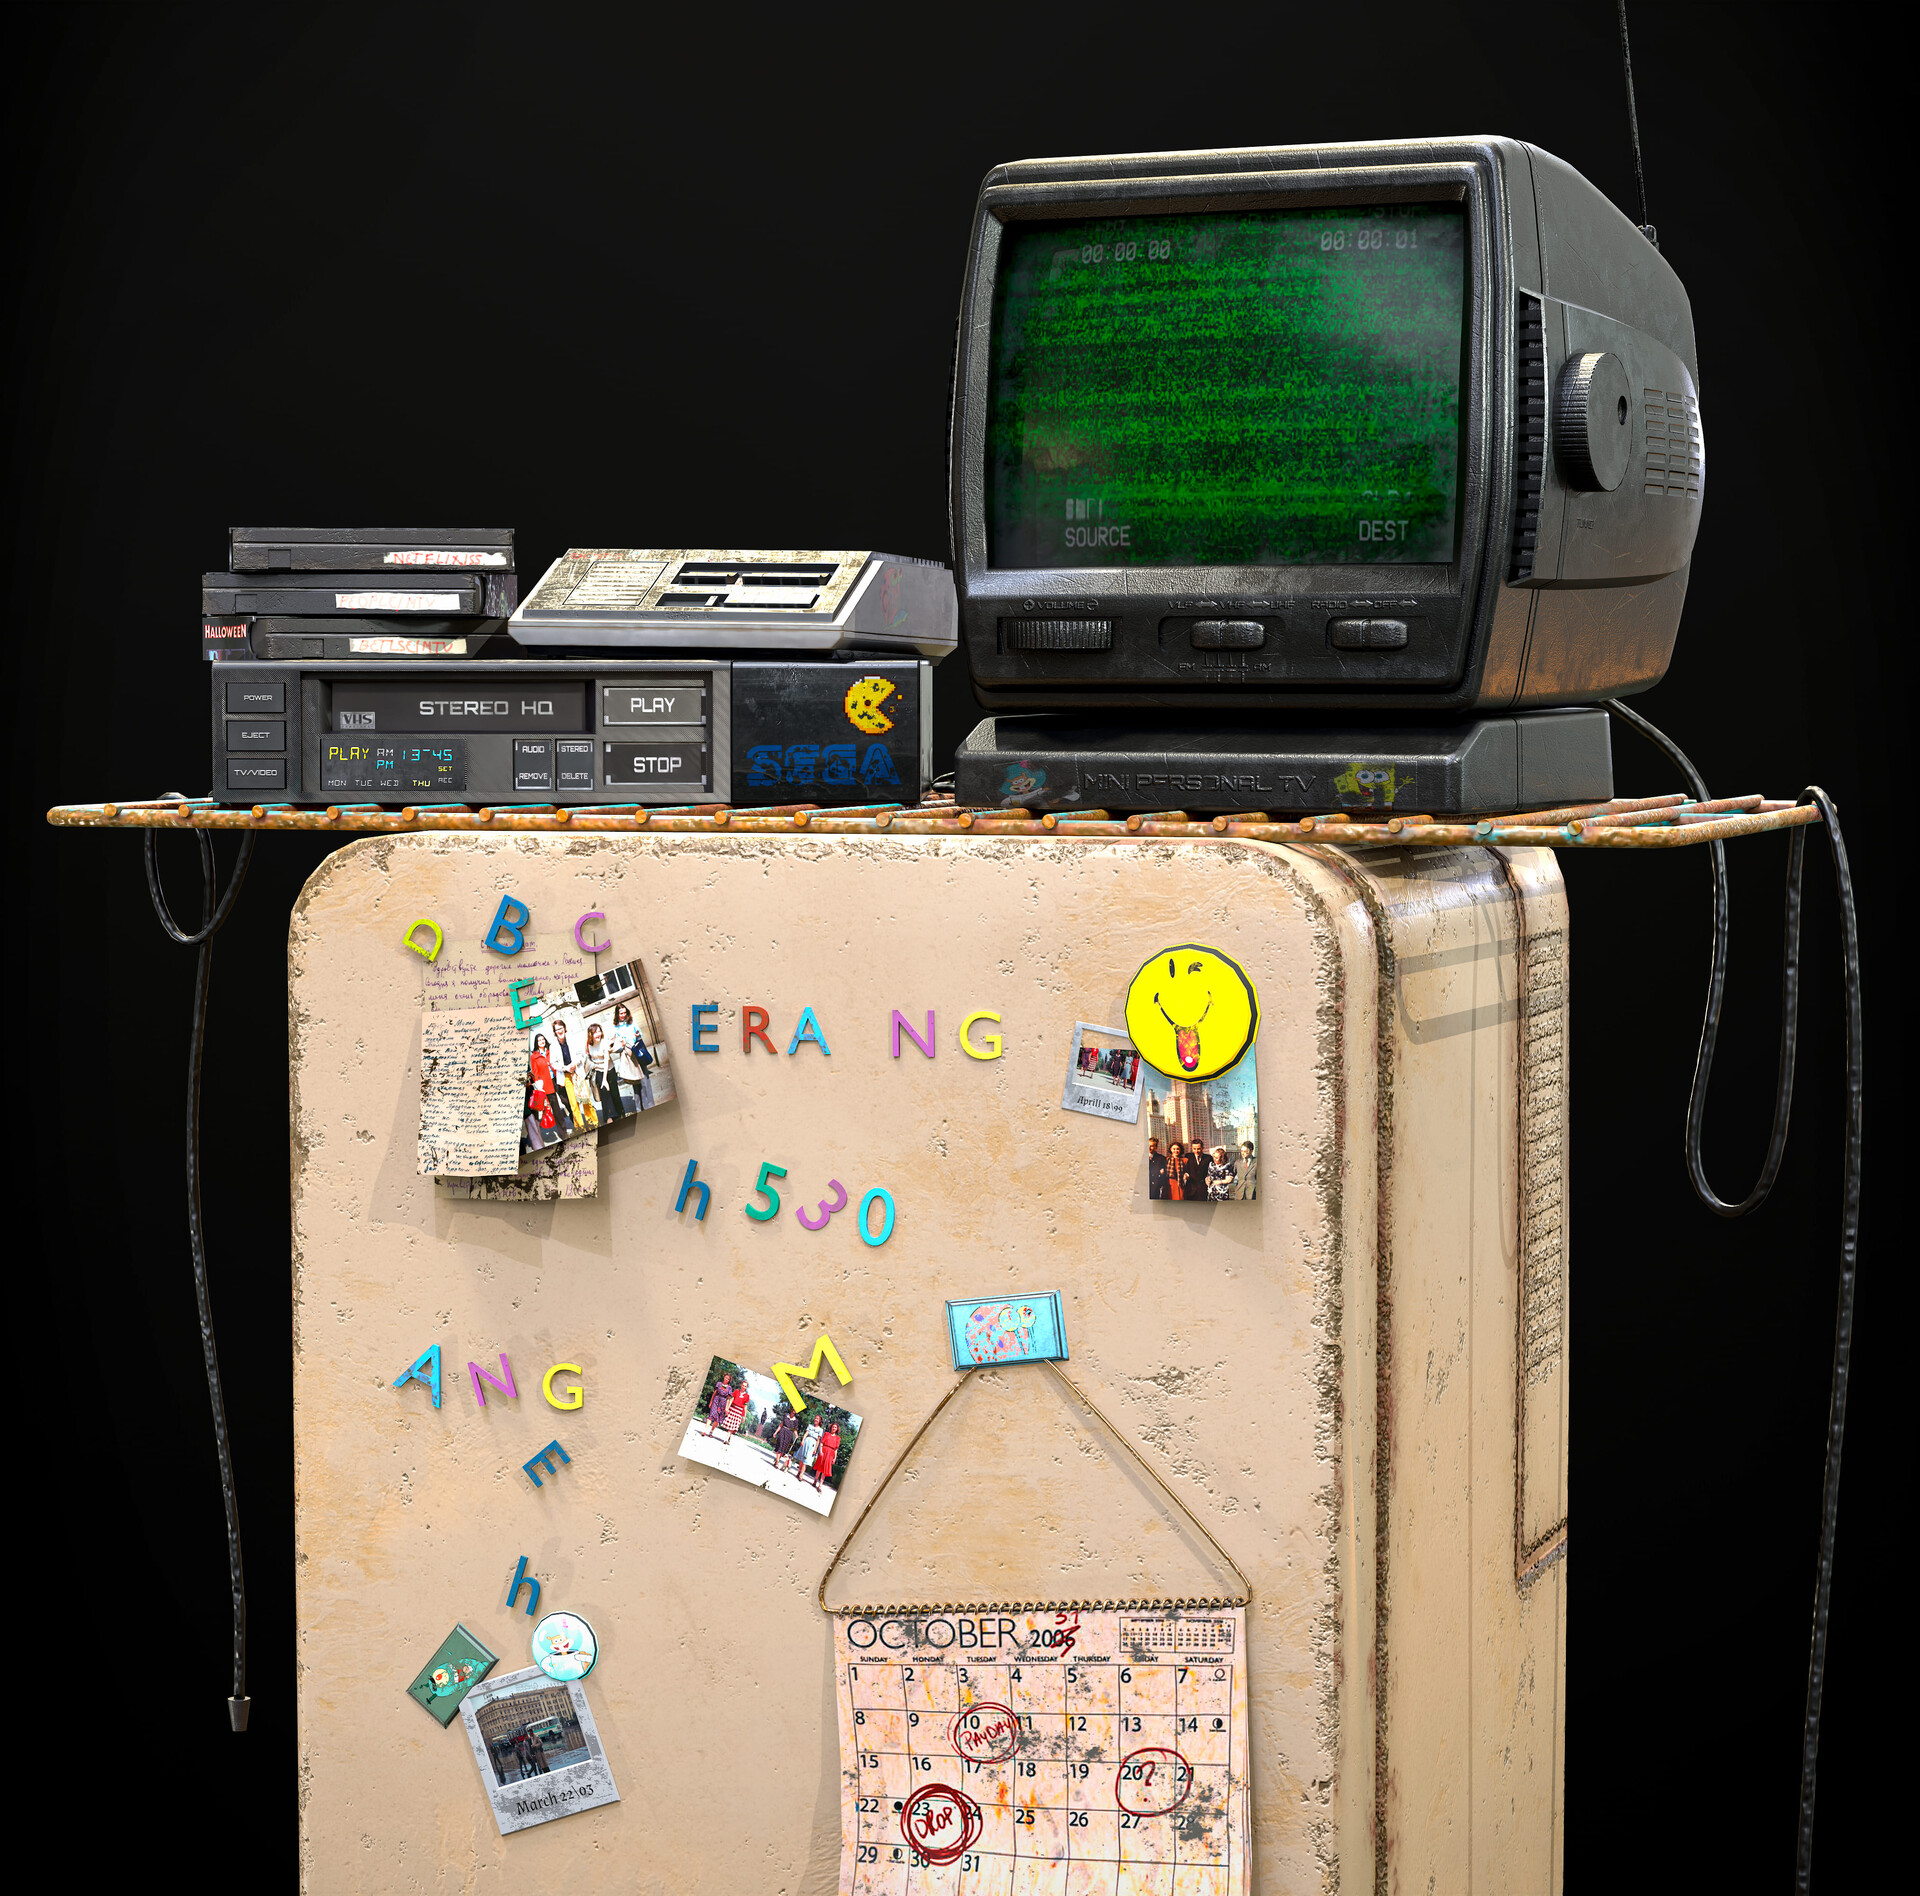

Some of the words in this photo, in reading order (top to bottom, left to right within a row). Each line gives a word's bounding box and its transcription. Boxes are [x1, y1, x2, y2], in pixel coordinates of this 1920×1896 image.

[1081, 239, 1171, 264] 00:00:00
[1320, 229, 1418, 251] 00:00:01
[1065, 525, 1131, 547] SOURCE
[1359, 520, 1409, 541] DEST
[1037, 600, 1085, 610] VOLUME
[1311, 601, 1349, 610] RADIO
[418, 700, 510, 715] STEREO
[521, 700, 554, 715] HQ
[630, 697, 676, 713] PLAY
[343, 713, 374, 725] VHS
[241, 731, 271, 739] EJECT
[328, 746, 370, 761] PLAY
[376, 748, 394, 757] AM
[522, 745, 545, 753] AUDIO
[376, 760, 394, 769] PM
[633, 756, 682, 773] STOP
[745, 743, 901, 787] SEGA
[327, 779, 347, 787] MON
[355, 779, 373, 787] TUE
[380, 779, 399, 787] WED
[412, 779, 431, 787] THU
[518, 772, 548, 780] REMOVE
[561, 772, 589, 780] DELETE
[1083, 773, 1130, 791] MINI
[1135, 773, 1273, 792] PERSONAL
[1279, 774, 1317, 792] TV
[485, 894, 530, 955] B
[574, 911, 612, 953] C
[509, 977, 543, 1031] E
[771, 1334, 853, 1414] M
[522, 1439, 571, 1488] E
[505, 1555, 541, 1616] h
[847, 1618, 1021, 1648] OCTOBER
[1184, 1656, 1225, 1664] SATURDAY
[851, 1667, 859, 1681] 1
[904, 1667, 915, 1682] 2
[959, 1667, 969, 1683] 3
[1011, 1668, 1023, 1683] 4
[1067, 1668, 1078, 1683] 5
[1120, 1668, 1131, 1683] 6
[1178, 1668, 1188, 1683] 7
[855, 1711, 866, 1725] 8
[908, 1712, 919, 1727] 9
[963, 1715, 980, 1729] 10
[1069, 1716, 1087, 1731] 12
[1122, 1717, 1142, 1732] 13
[1179, 1717, 1199, 1732] 14
[860, 1754, 879, 1768] 15
[912, 1757, 932, 1771] 16
[964, 1760, 982, 1774] 17
[1018, 1763, 1036, 1777] 18
[1070, 1764, 1089, 1779] 19
[1122, 1765, 1143, 1780] 20
[1177, 1766, 1195, 1781] 21
[516, 1792, 558, 1816] March
[860, 1798, 879, 1812] 22
[912, 1802, 930, 1816] 23
[1015, 1809, 1035, 1825] 25
[1069, 1812, 1089, 1827] 26
[1121, 1814, 1141, 1829] 27
[857, 1846, 878, 1863] 29
[962, 1854, 980, 1872] 31
